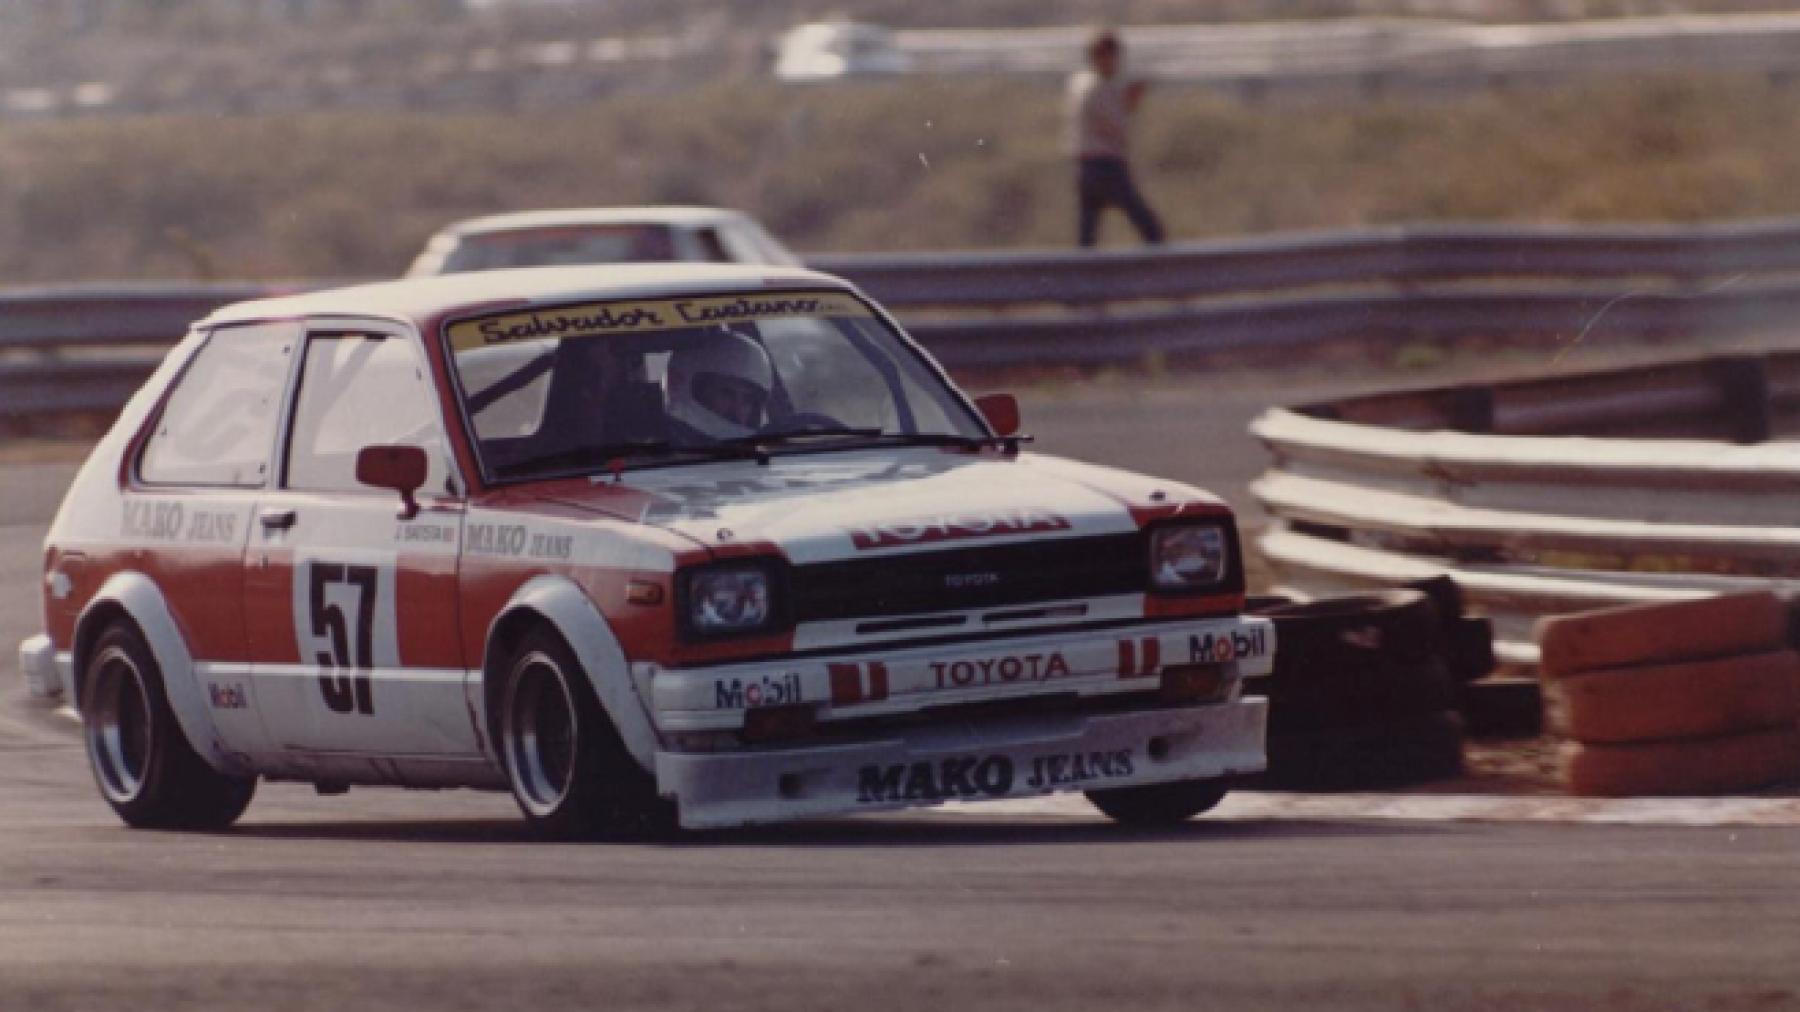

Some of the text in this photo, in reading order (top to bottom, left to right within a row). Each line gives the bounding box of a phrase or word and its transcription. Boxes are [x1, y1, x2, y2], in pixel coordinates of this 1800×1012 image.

[479, 296, 818, 344] Salvador Caetano
[466, 524, 526, 555] MAKO
[944, 571, 1000, 588] TOYOTA
[310, 562, 377, 715] 57
[1188, 628, 1265, 663] Mobil
[929, 653, 1070, 688] TOYOTA
[715, 674, 801, 708] Mobil
[857, 748, 1134, 802] MAKO JEANS
